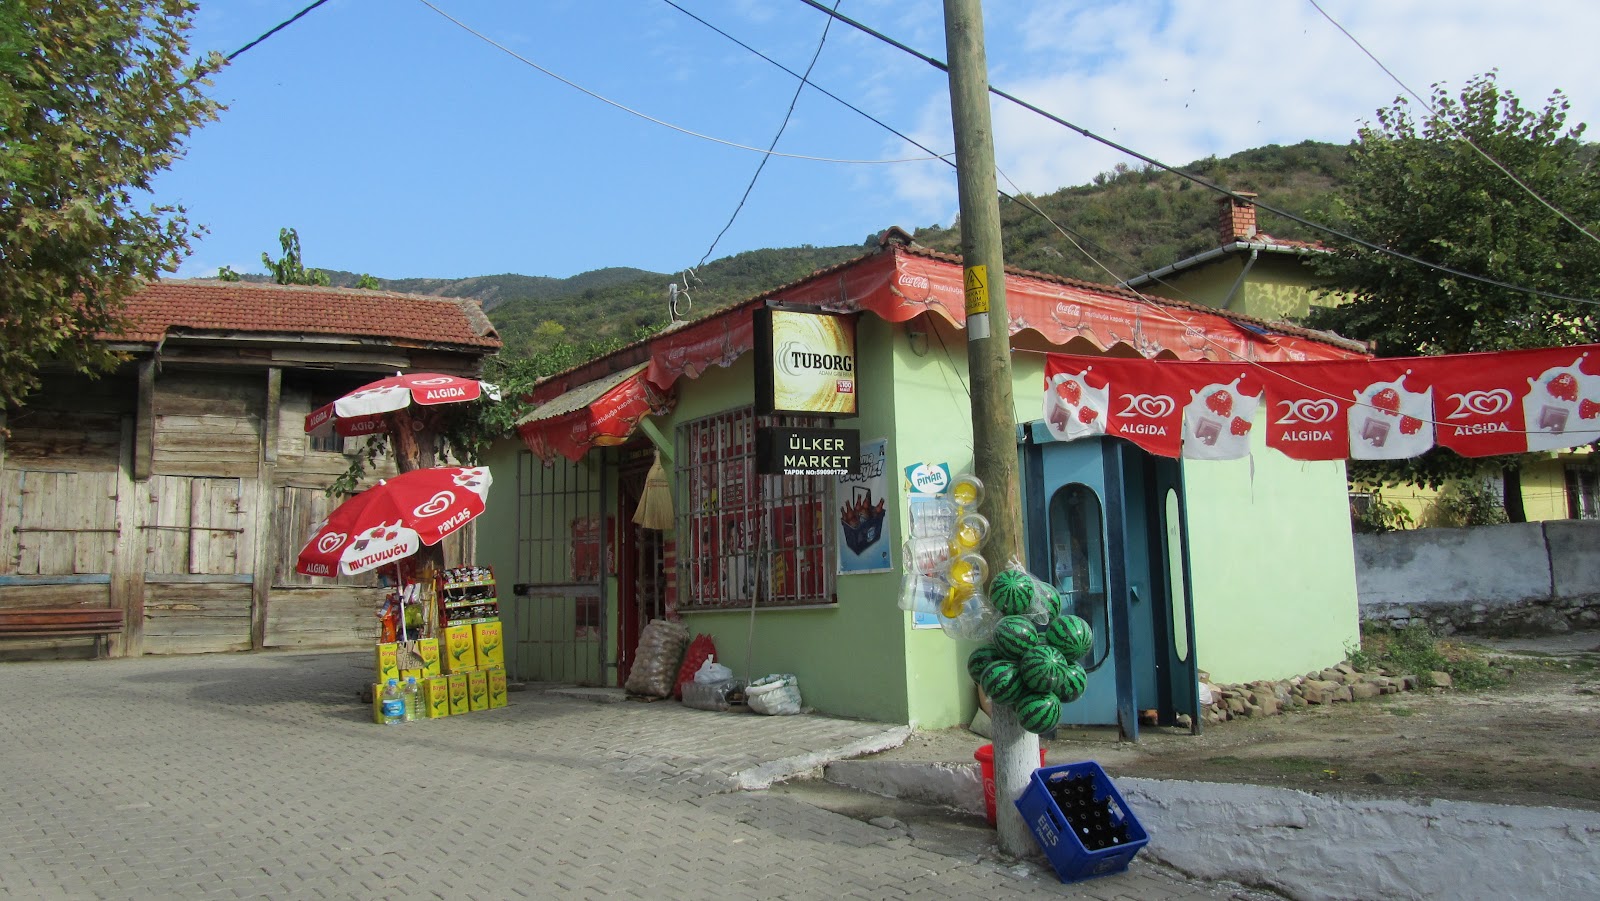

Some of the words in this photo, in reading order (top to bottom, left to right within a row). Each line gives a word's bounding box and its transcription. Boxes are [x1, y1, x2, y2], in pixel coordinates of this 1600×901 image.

[792, 352, 852, 372] TUBORG
[790, 434, 844, 451] ÜLKER
[784, 455, 851, 468] MARKET
[349, 544, 408, 572] MUTLULUĞU
[1038, 814, 1059, 846] EFES
